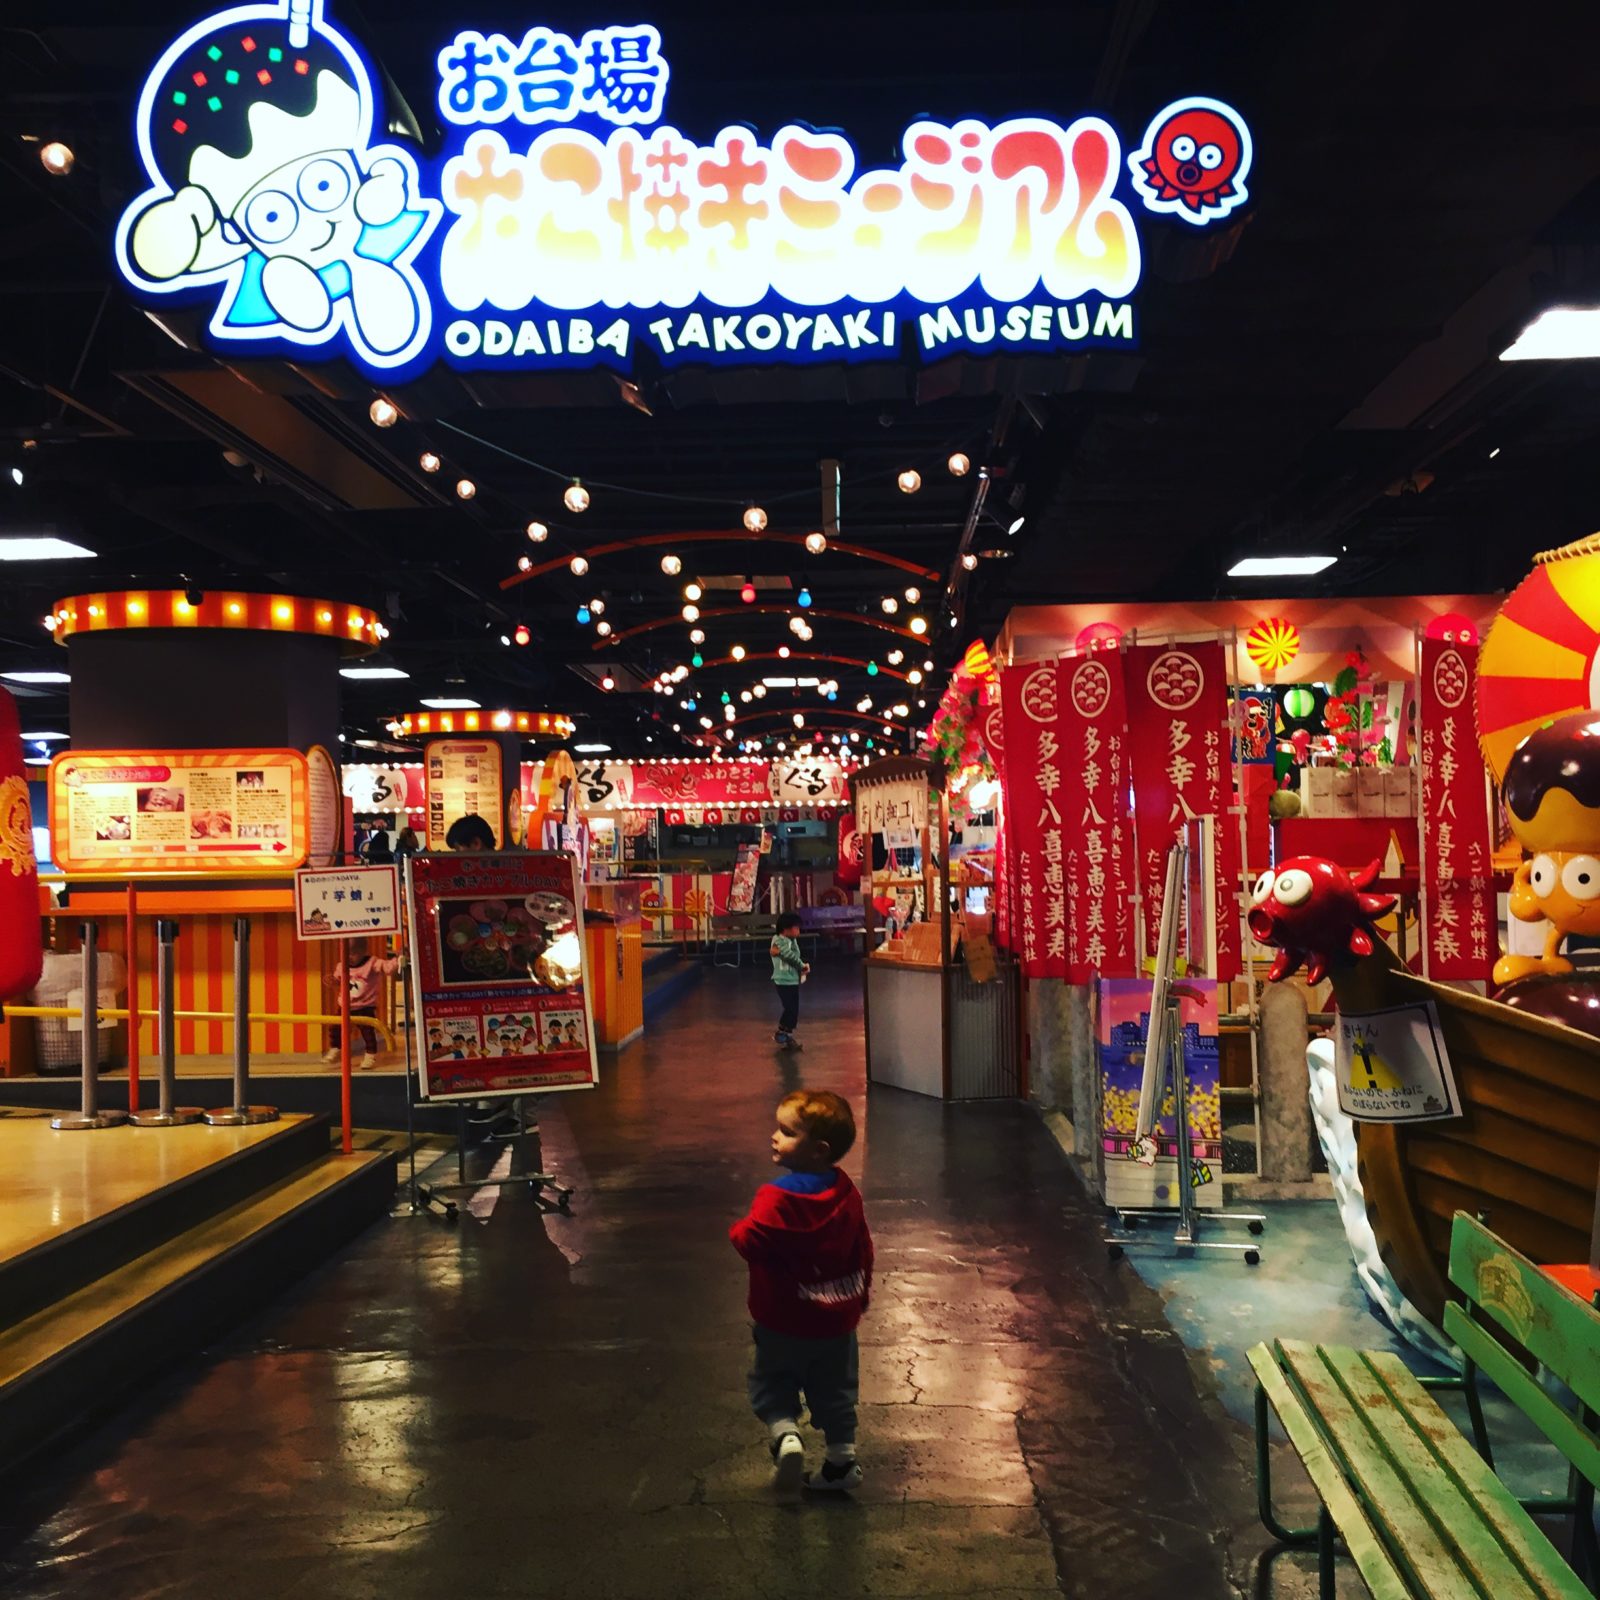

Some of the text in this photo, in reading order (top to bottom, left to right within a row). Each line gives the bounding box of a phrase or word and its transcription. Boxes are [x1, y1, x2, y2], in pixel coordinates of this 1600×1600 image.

[446, 36, 661, 115] お台場
[445, 303, 1134, 357] ODAIBA TAKOYAKI MUSEUM
[1080, 725, 1108, 969] 多幸八喜恵美寿
